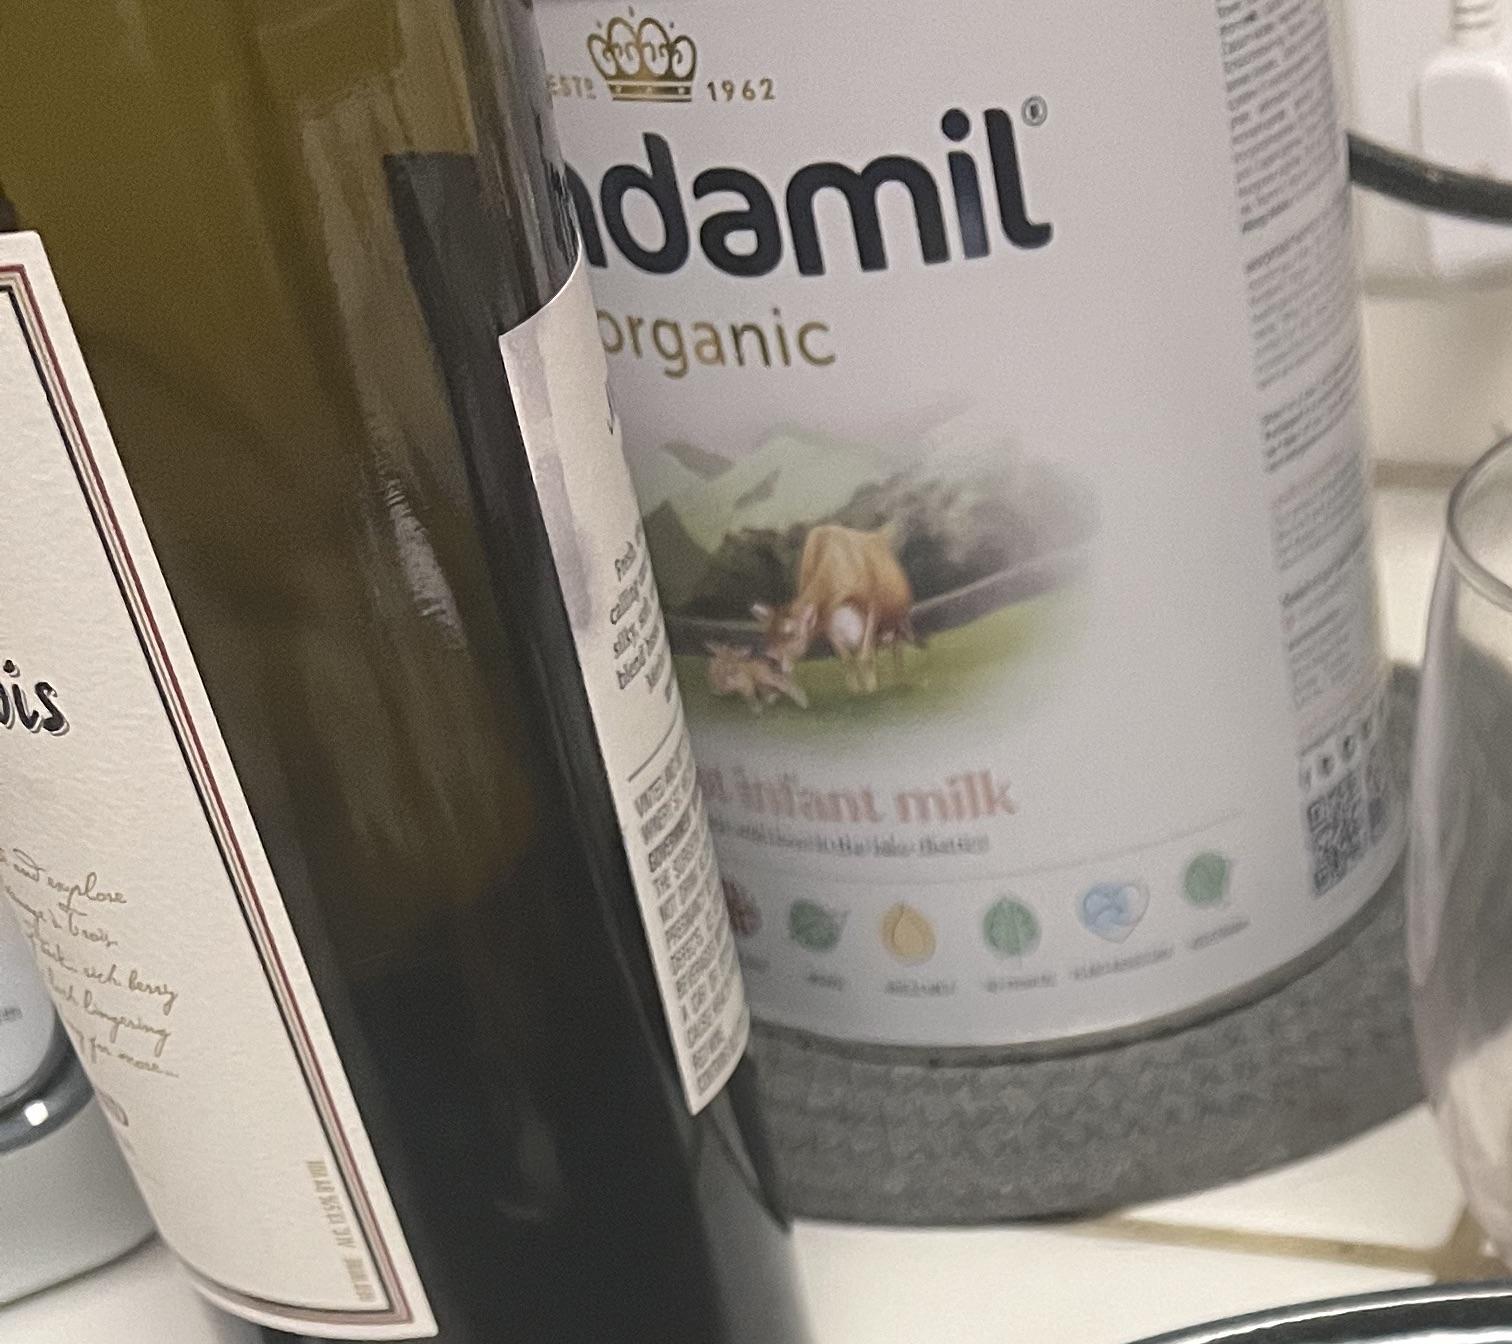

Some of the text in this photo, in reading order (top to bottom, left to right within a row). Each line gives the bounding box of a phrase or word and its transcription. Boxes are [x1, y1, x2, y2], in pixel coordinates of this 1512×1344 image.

[706, 77, 776, 102] 1962
[597, 308, 836, 379] organic
[894, 769, 1016, 824] milk
[48, 871, 127, 907] explore
[128, 969, 179, 1016] berry
[84, 990, 171, 1058] lingering
